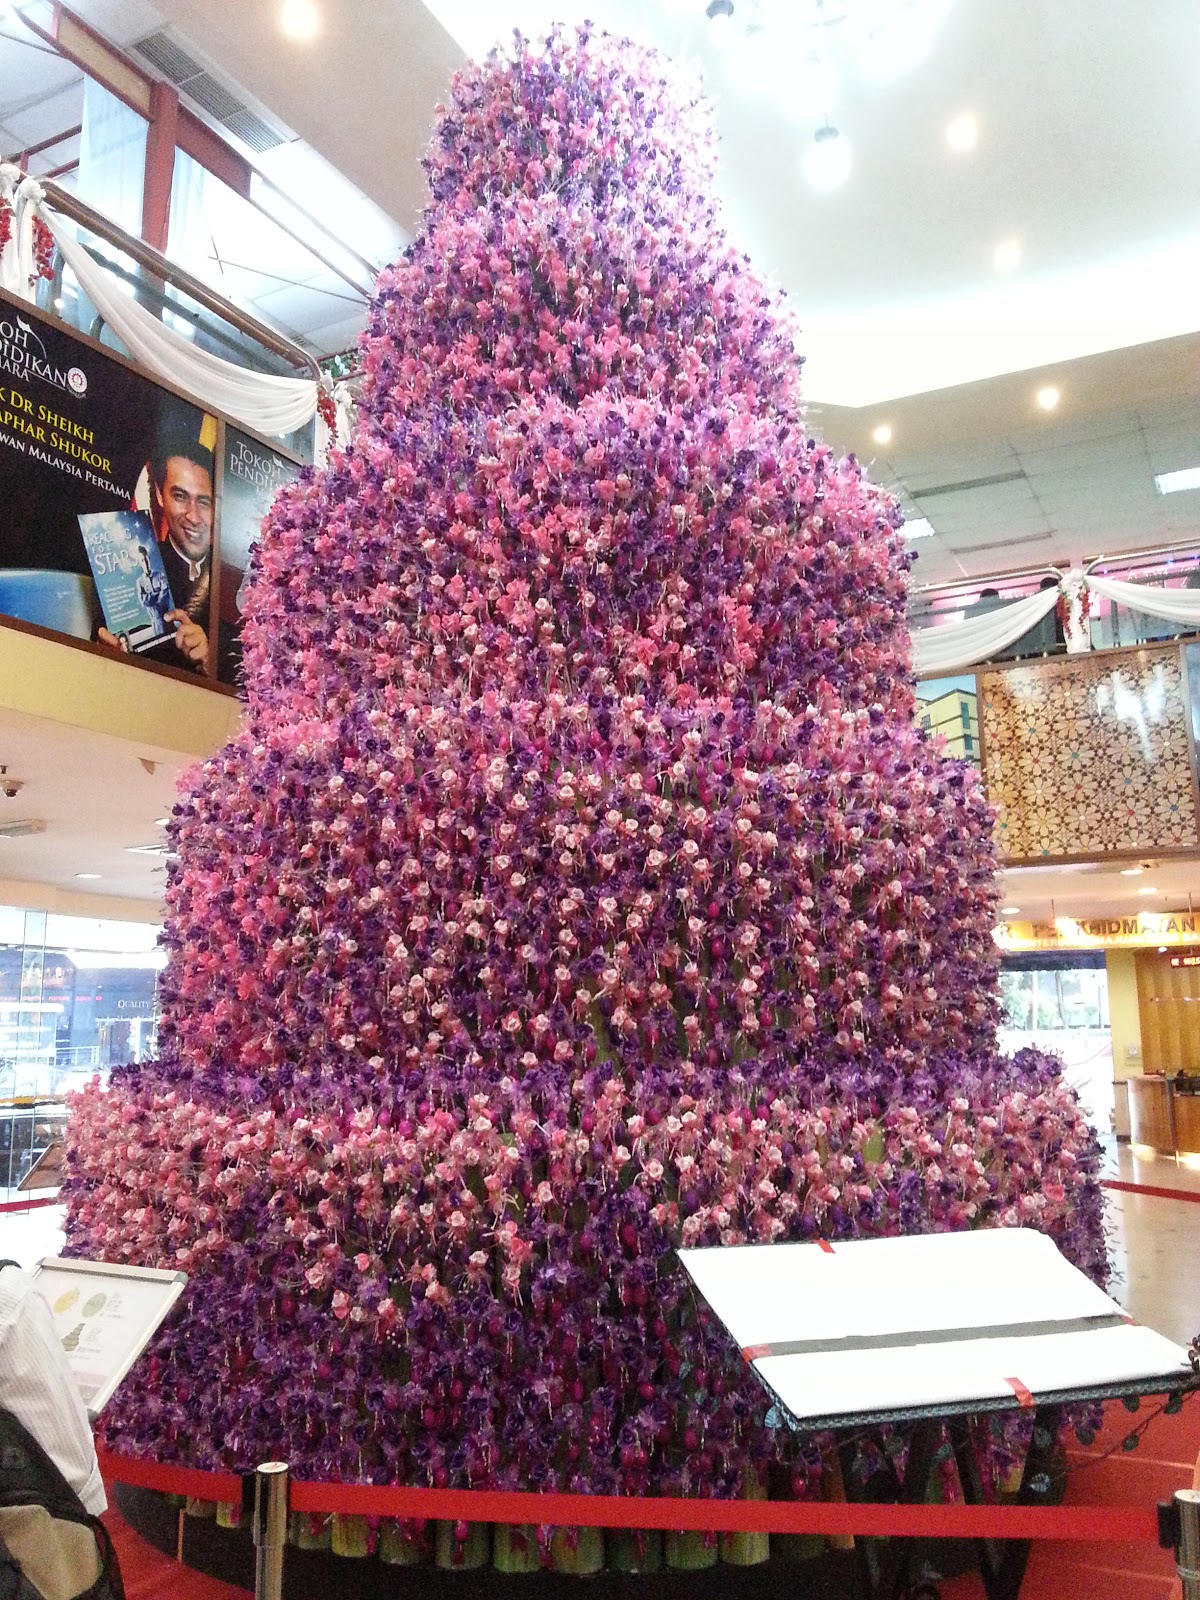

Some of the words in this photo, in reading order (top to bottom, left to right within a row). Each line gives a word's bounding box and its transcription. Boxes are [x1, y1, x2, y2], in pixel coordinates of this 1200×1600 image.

[10, 390, 34, 416] DR
[38, 405, 94, 444] SHEIKH
[28, 445, 82, 479] MALAYSIA
[85, 470, 131, 501] PERTAMA
[50, 432, 112, 474] SHUKOR
[237, 441, 281, 480] TOKOH
